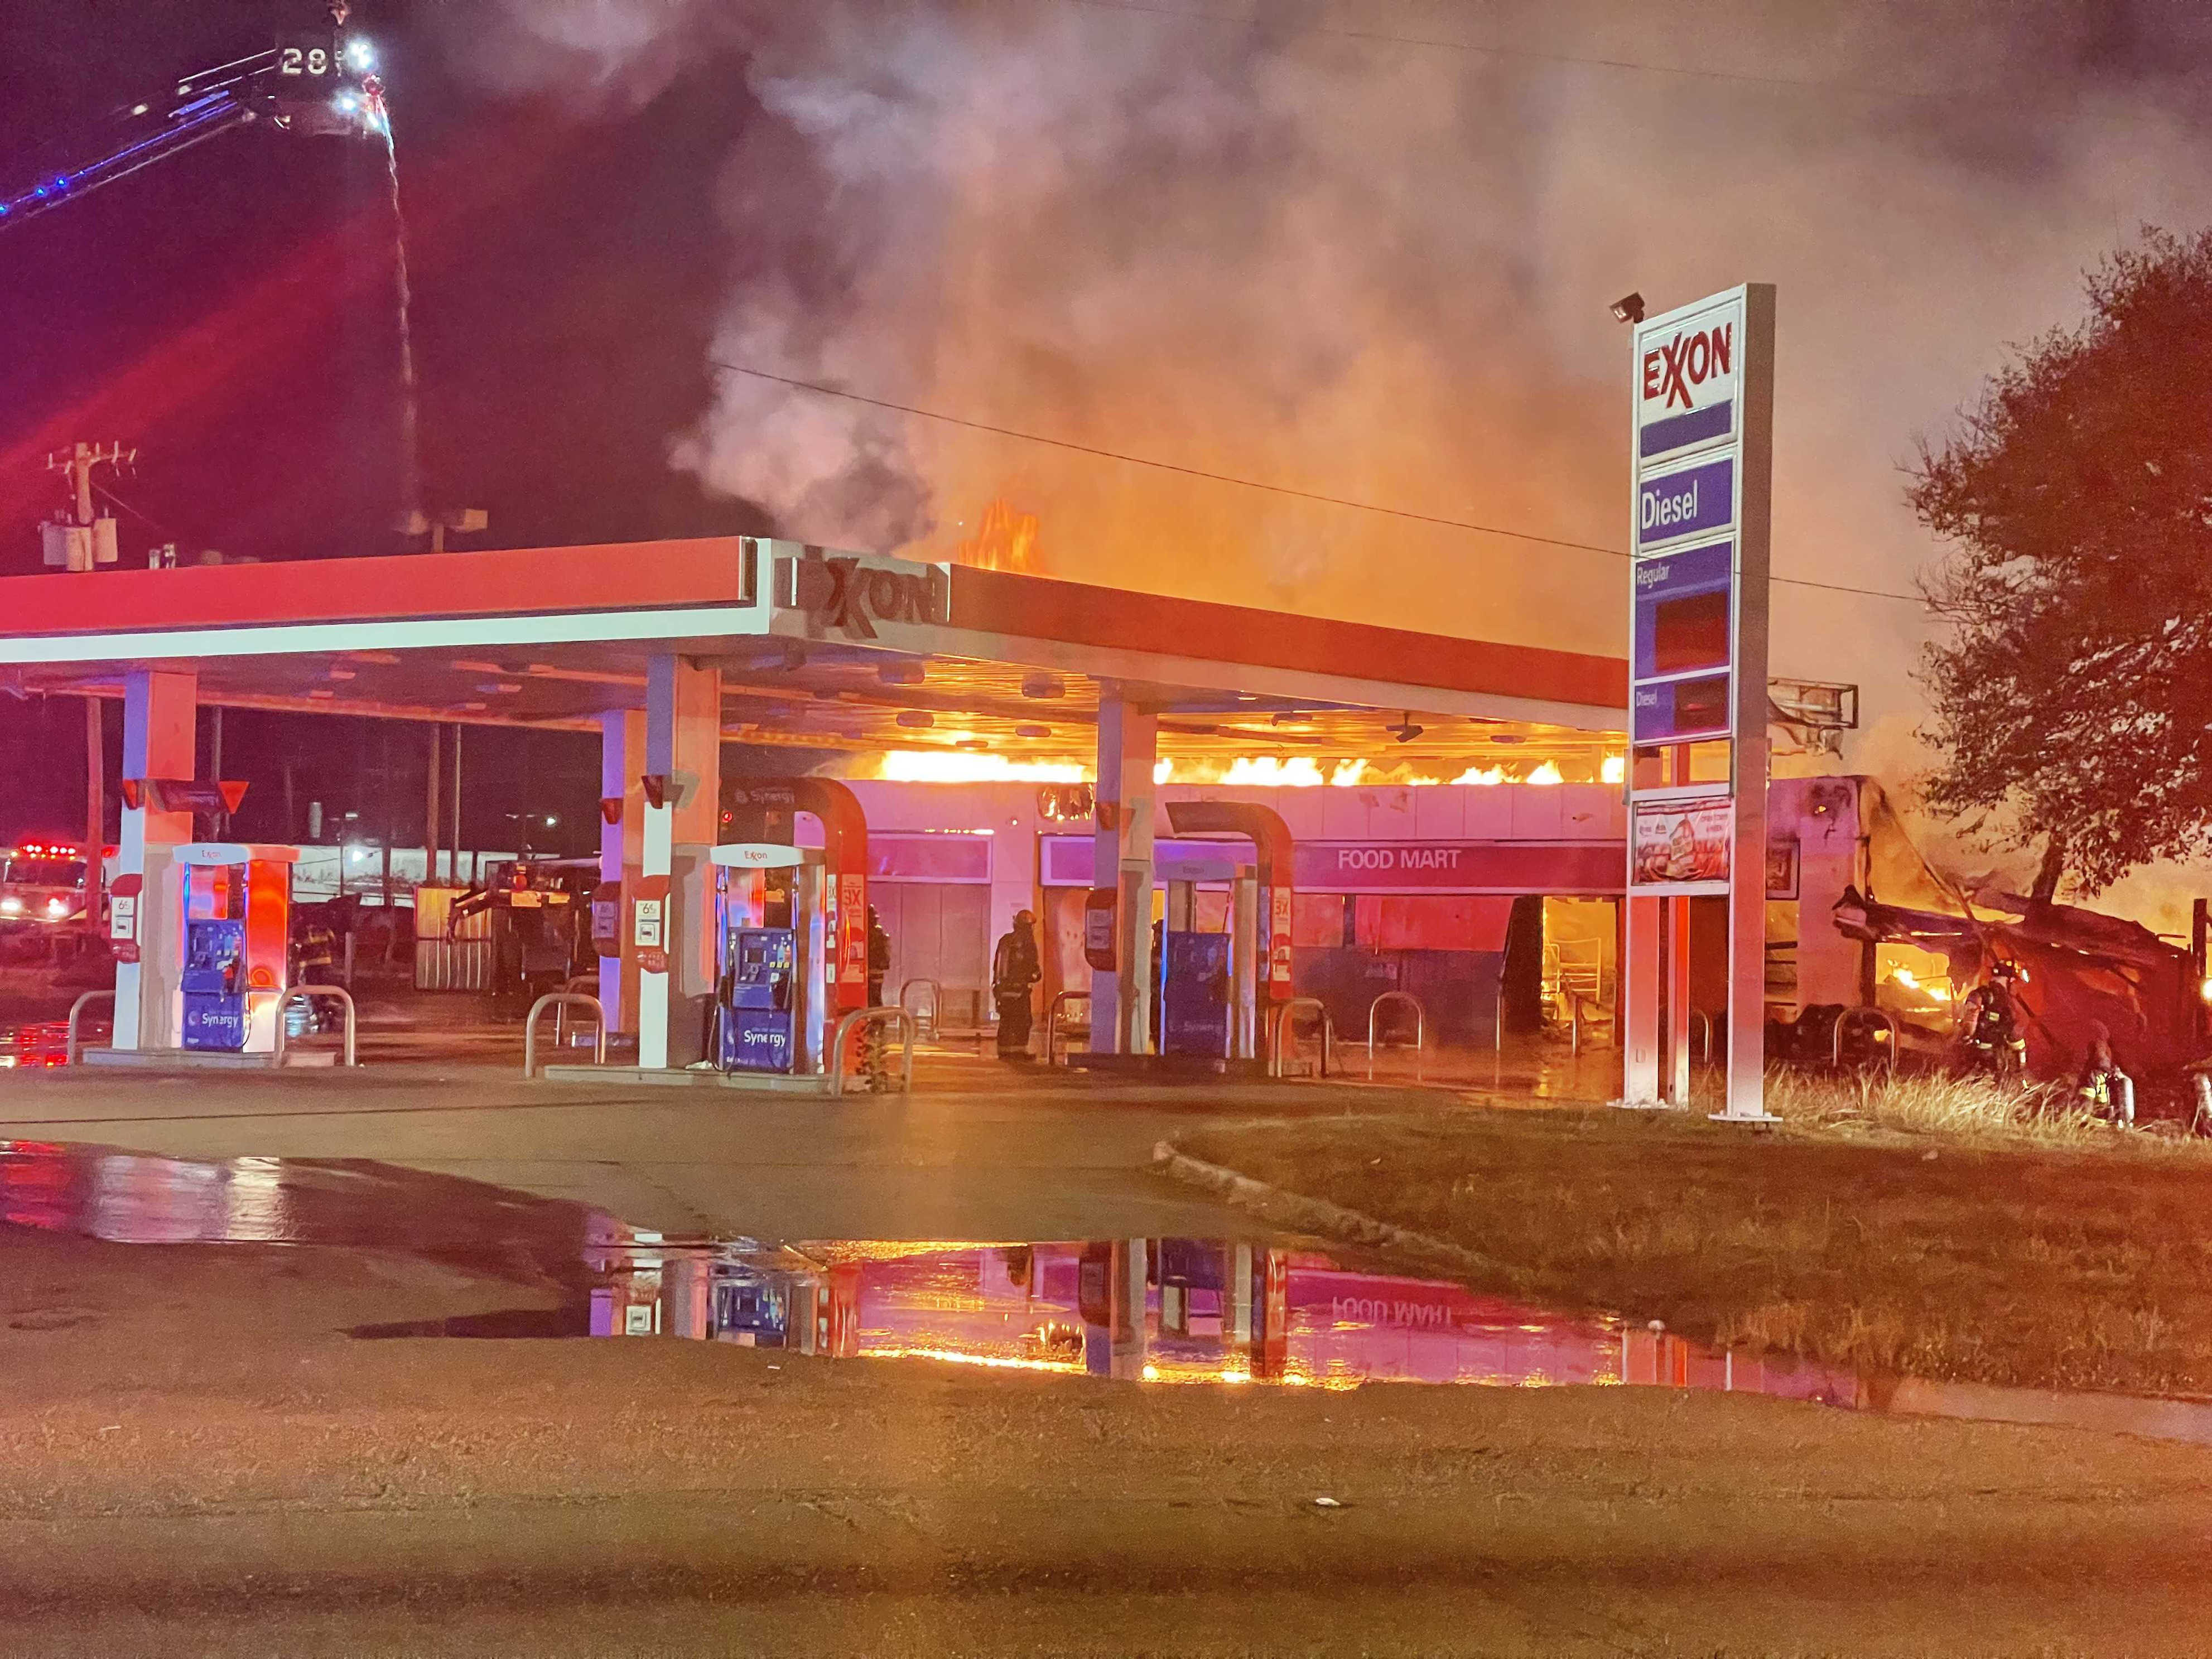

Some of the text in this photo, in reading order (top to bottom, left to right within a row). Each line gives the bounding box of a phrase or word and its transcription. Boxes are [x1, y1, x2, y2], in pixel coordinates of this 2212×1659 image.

[282, 48, 327, 75] 28
[1644, 321, 1732, 409] EXXON
[1642, 480, 1698, 529] Diesel
[1637, 562, 1669, 589] Regular
[1636, 689, 1657, 707] Diesel
[744, 851, 767, 861] Exxon
[1339, 850, 1461, 869] FOOD MART
[1275, 900, 1288, 915] 3X
